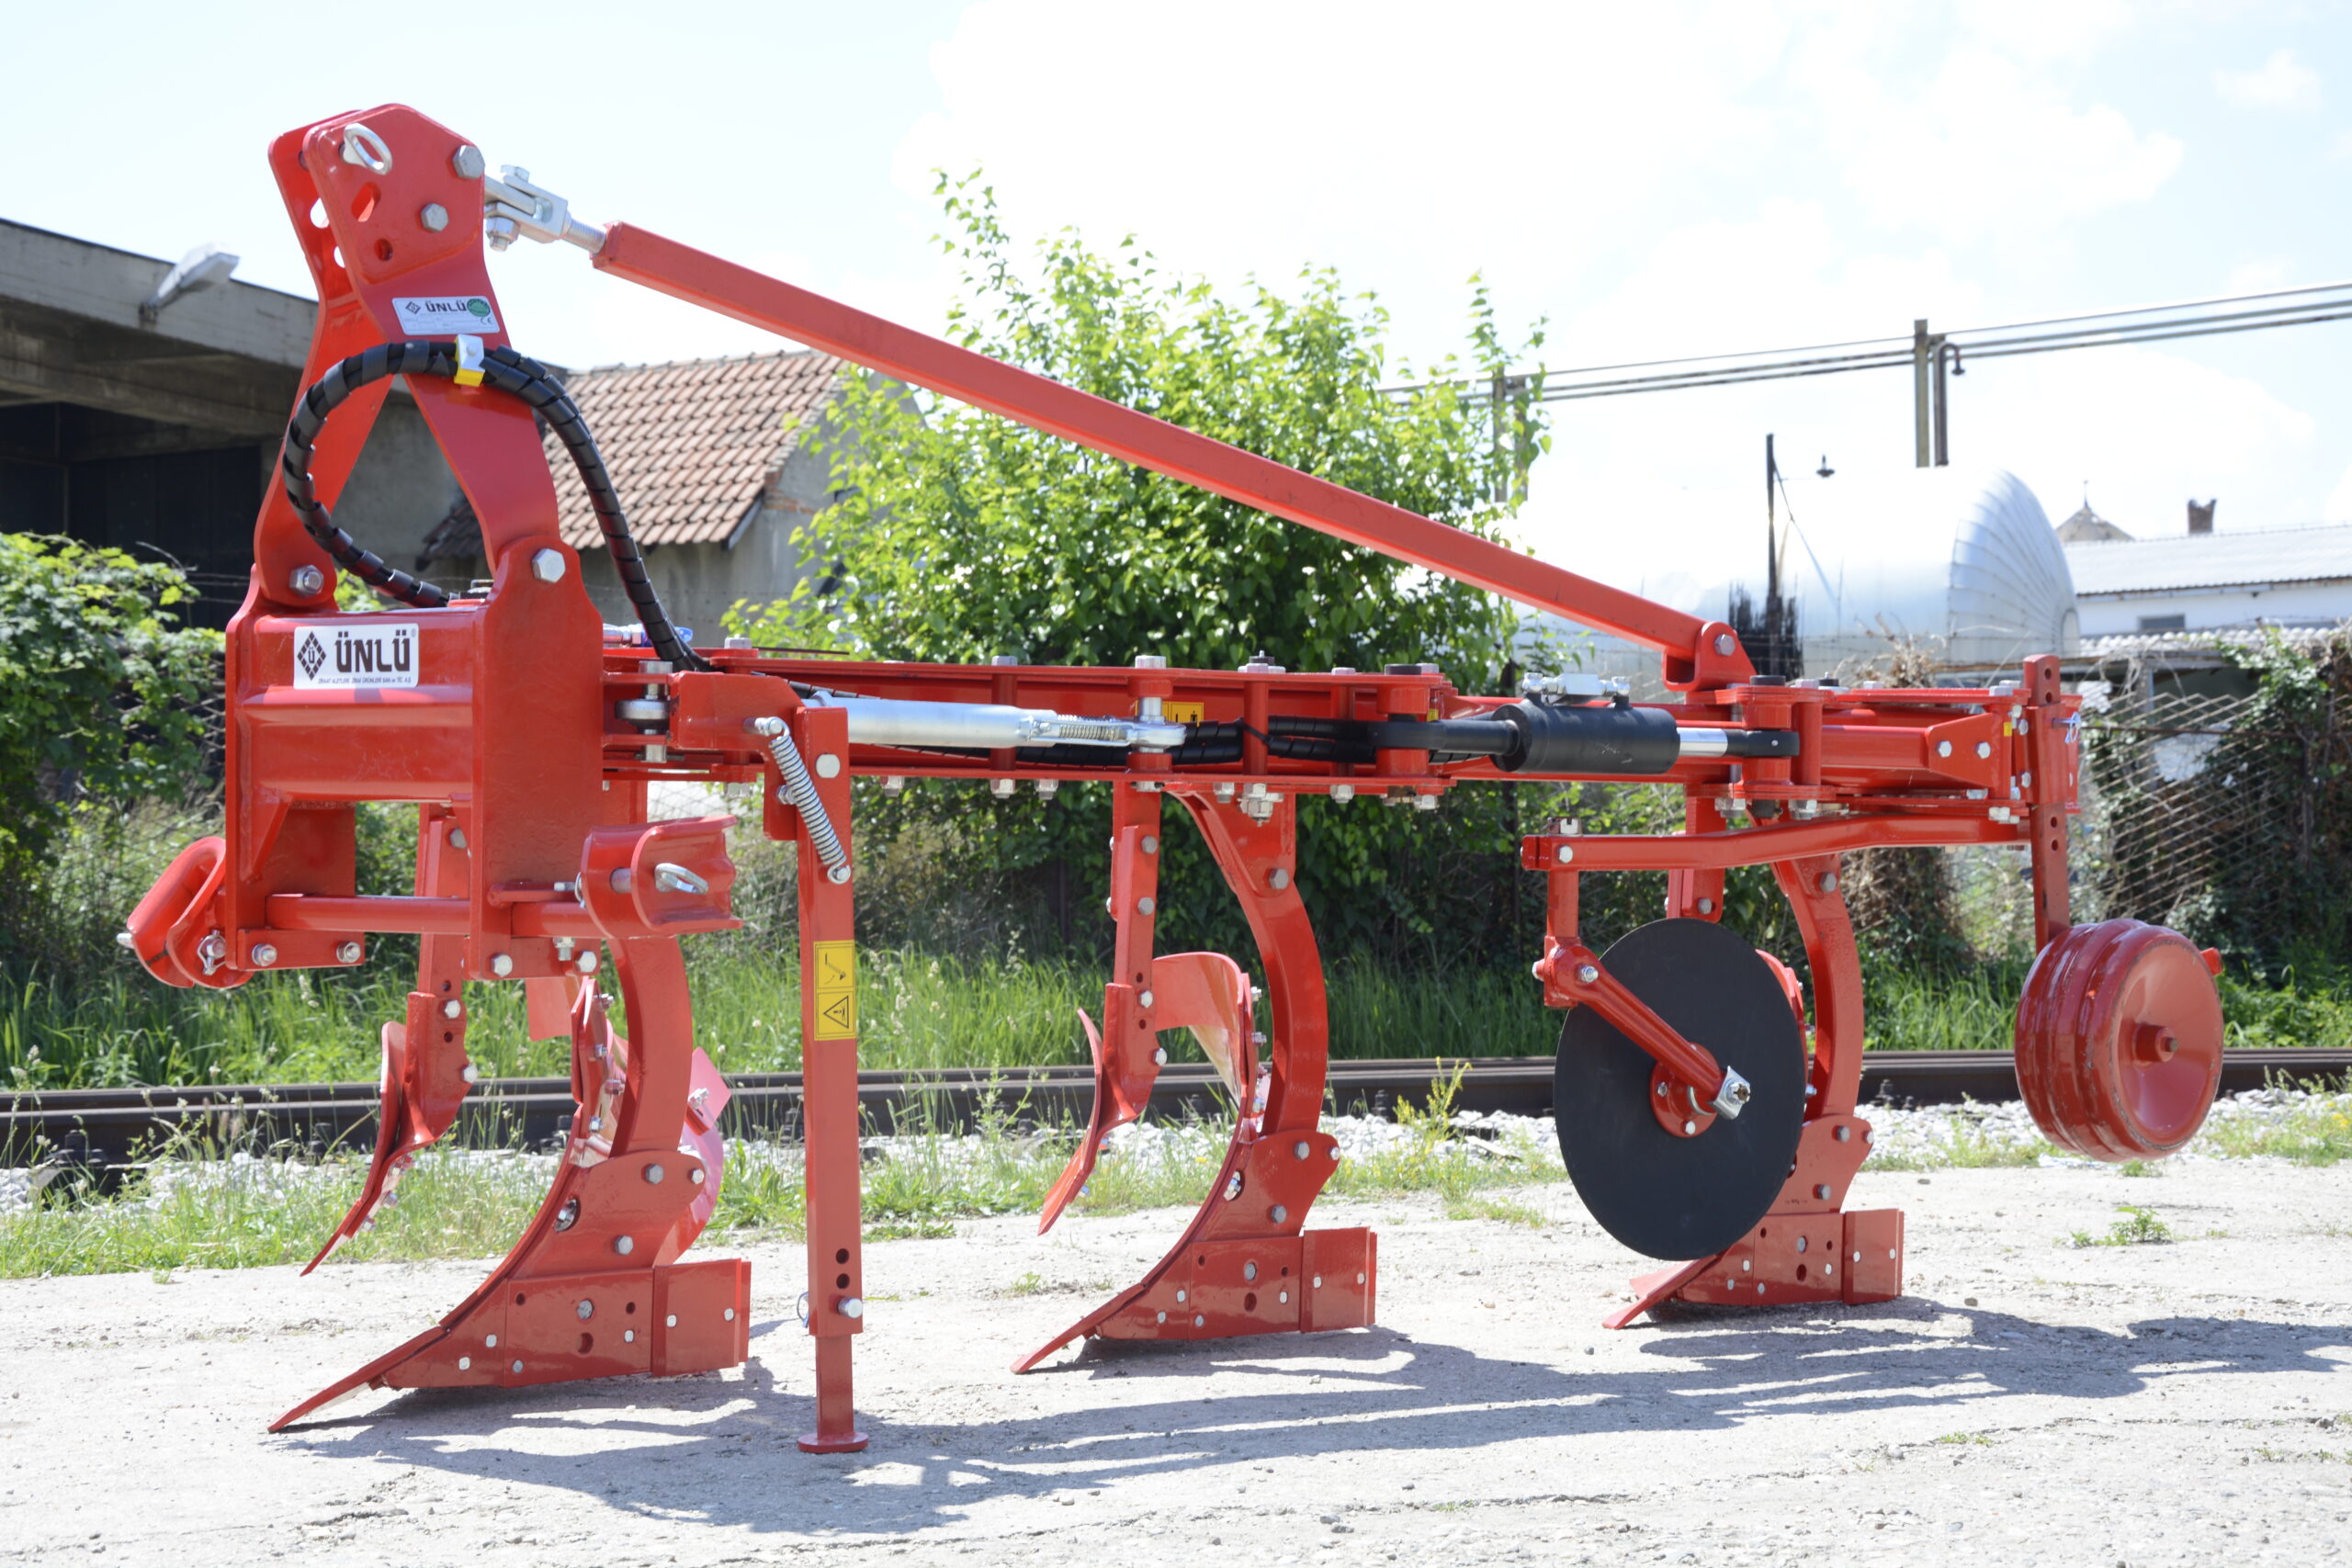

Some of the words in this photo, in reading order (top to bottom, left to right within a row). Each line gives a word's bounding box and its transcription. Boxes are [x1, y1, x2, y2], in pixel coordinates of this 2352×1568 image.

[424, 300, 467, 312] ÜNLÜ
[308, 647, 315, 664] Ü
[334, 629, 410, 672] ÜNLÜ
